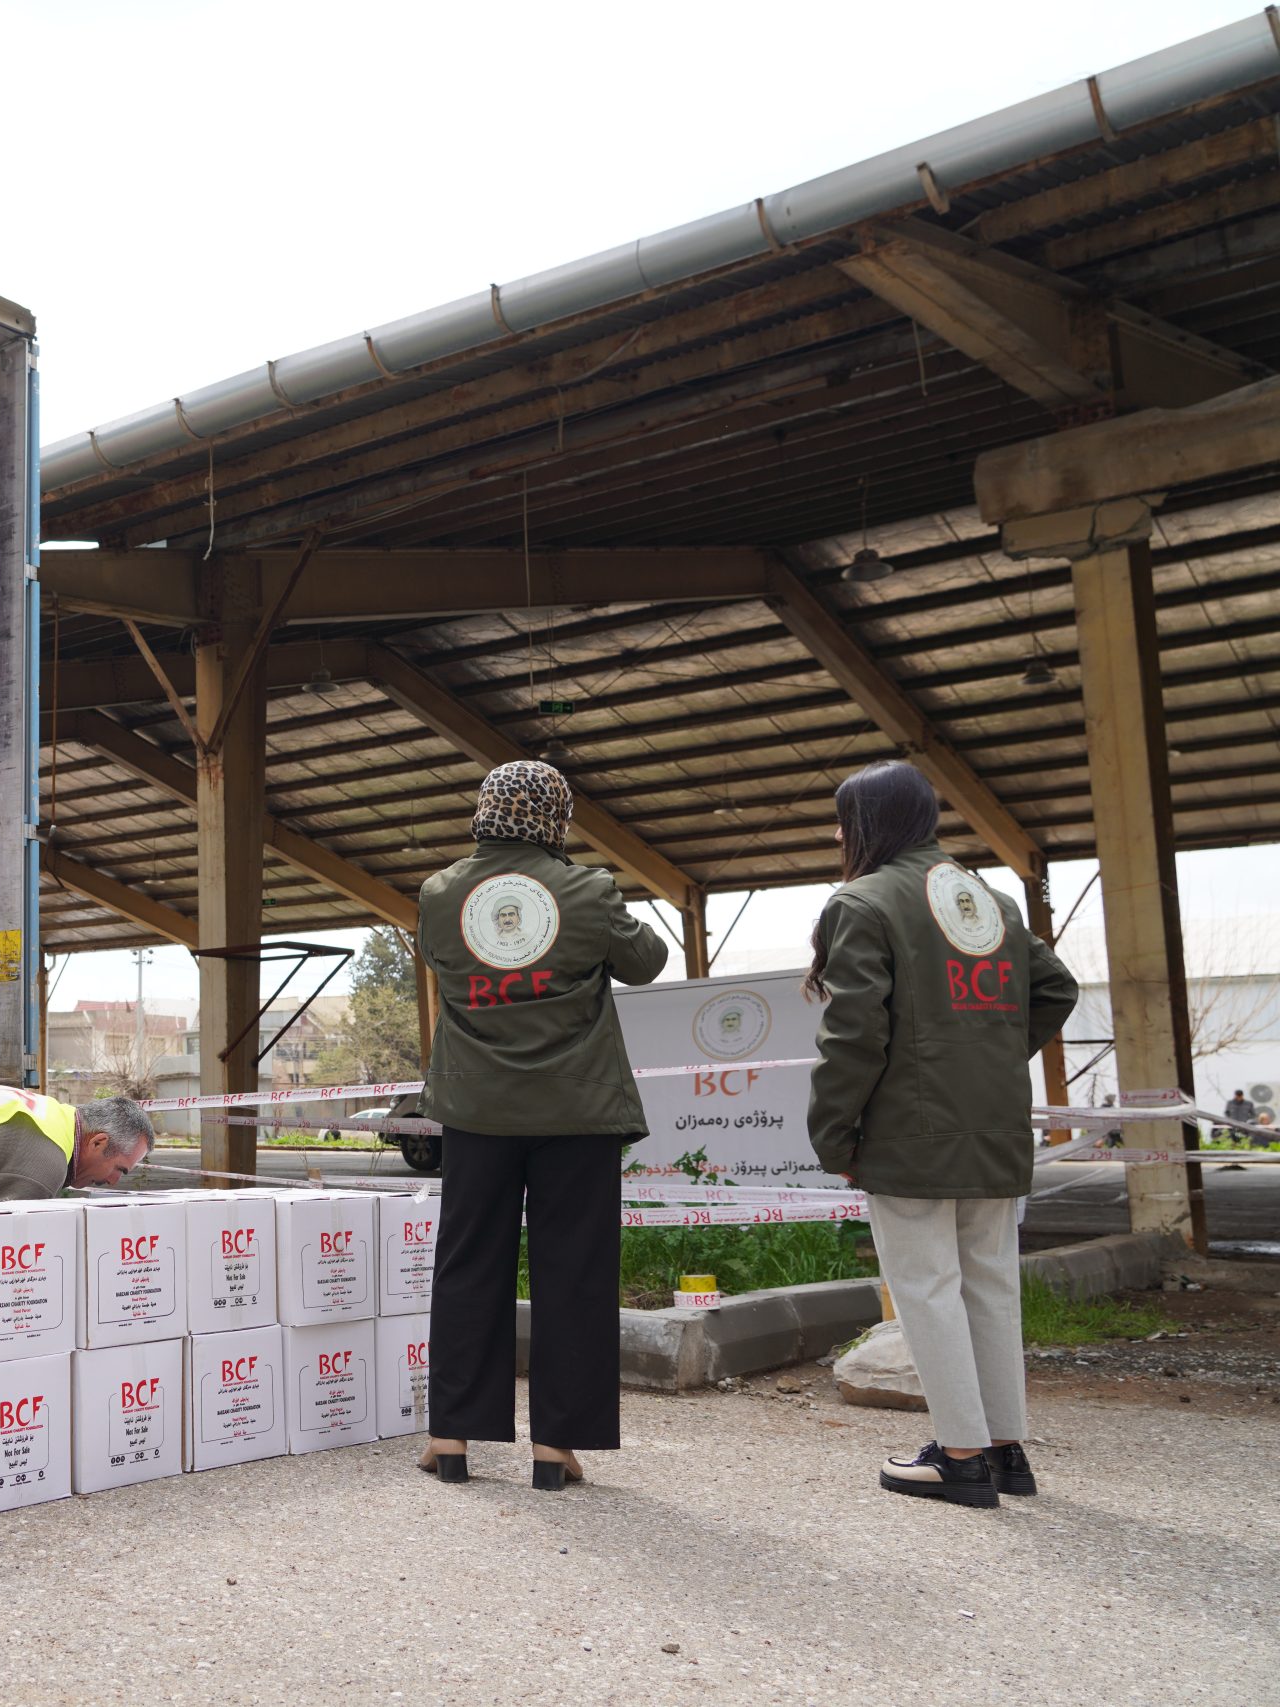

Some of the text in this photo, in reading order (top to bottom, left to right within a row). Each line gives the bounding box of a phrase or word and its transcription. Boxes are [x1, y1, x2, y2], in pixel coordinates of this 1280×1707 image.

[468, 971, 553, 1009] BCF
[946, 960, 1013, 1001] BCF
[321, 1088, 343, 1098] BCF
[374, 1084, 397, 1094] BCF
[694, 1068, 762, 1096] BCF
[178, 1097, 198, 1107] BCF
[223, 1094, 243, 1105] BCF
[271, 1091, 292, 1101] BCF
[733, 1110, 784, 1129] پرۆژەی
[683, 1210, 711, 1224] BCF
[754, 1208, 782, 1222] BCF
[829, 1205, 861, 1219] BCF
[121, 1235, 159, 1260] BCF
[222, 1229, 255, 1254] BCF
[320, 1231, 353, 1252] BCF
[1, 1243, 45, 1269] BCF
[319, 1351, 352, 1375] BCF
[407, 1342, 429, 1366] BC
[222, 1356, 258, 1382] BCF
[122, 1378, 159, 1408] BCF
[0, 1396, 43, 1429] BCF
